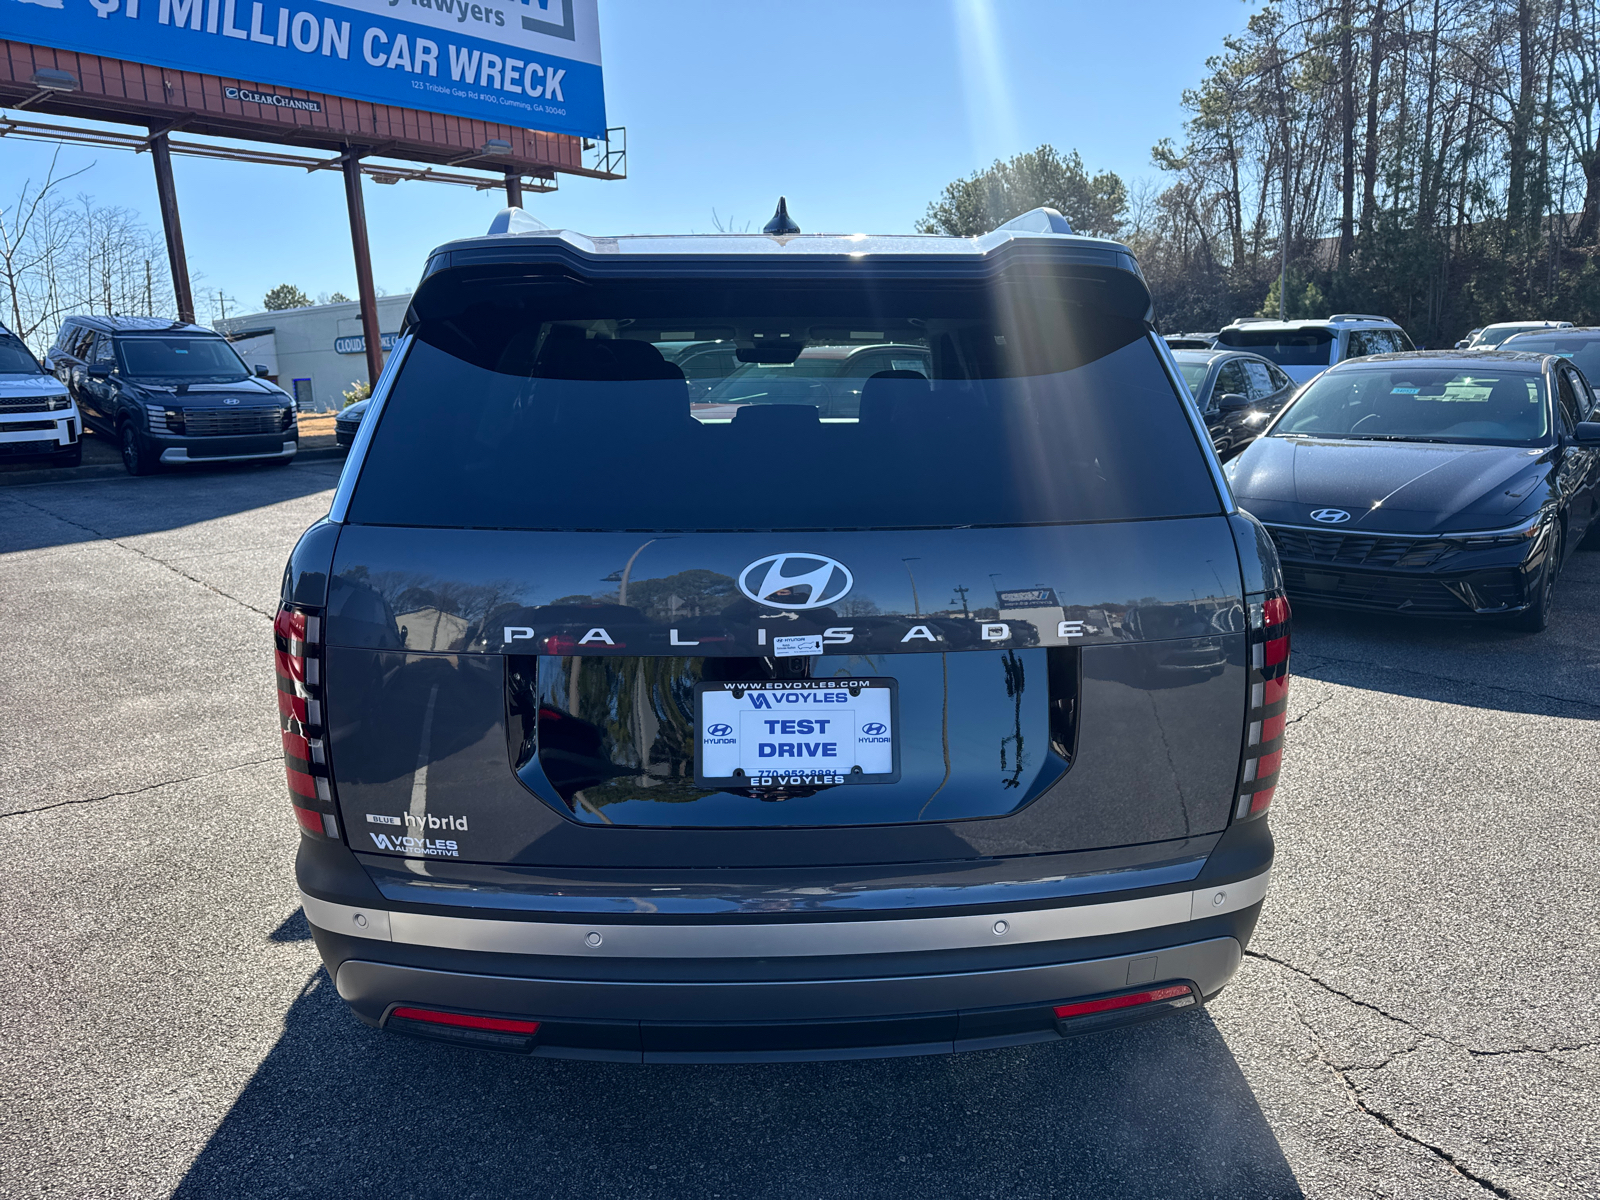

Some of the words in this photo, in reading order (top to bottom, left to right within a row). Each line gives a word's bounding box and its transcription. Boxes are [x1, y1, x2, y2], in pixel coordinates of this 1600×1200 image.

[411, 0, 506, 27] awyers
[158, 0, 350, 60] MILLION
[362, 27, 439, 77] CAR
[448, 44, 567, 102] WRECK
[411, 80, 424, 90] 123
[426, 82, 451, 95] Tribble
[452, 88, 467, 98] Gap
[468, 92, 479, 100] Rd
[480, 93, 499, 104] #100,
[499, 97, 533, 111] Cumming,
[533, 103, 544, 112] GA
[544, 105, 567, 116] 30040
[336, 338, 362, 353] CLOUD
[503, 620, 1085, 646] PALISADE
[724, 680, 870, 690] WWW.EDVOYLES.COM
[772, 692, 848, 704] VOYLES
[764, 719, 831, 735] TEST
[758, 742, 838, 758] DRIVE
[750, 777, 772, 786] ED
[778, 775, 845, 785] VOYLES
[372, 815, 395, 824] BLUE
[403, 811, 469, 831] hybrid
[391, 835, 458, 850] VOYLES
[395, 845, 460, 857] AUTOMOTIVE
